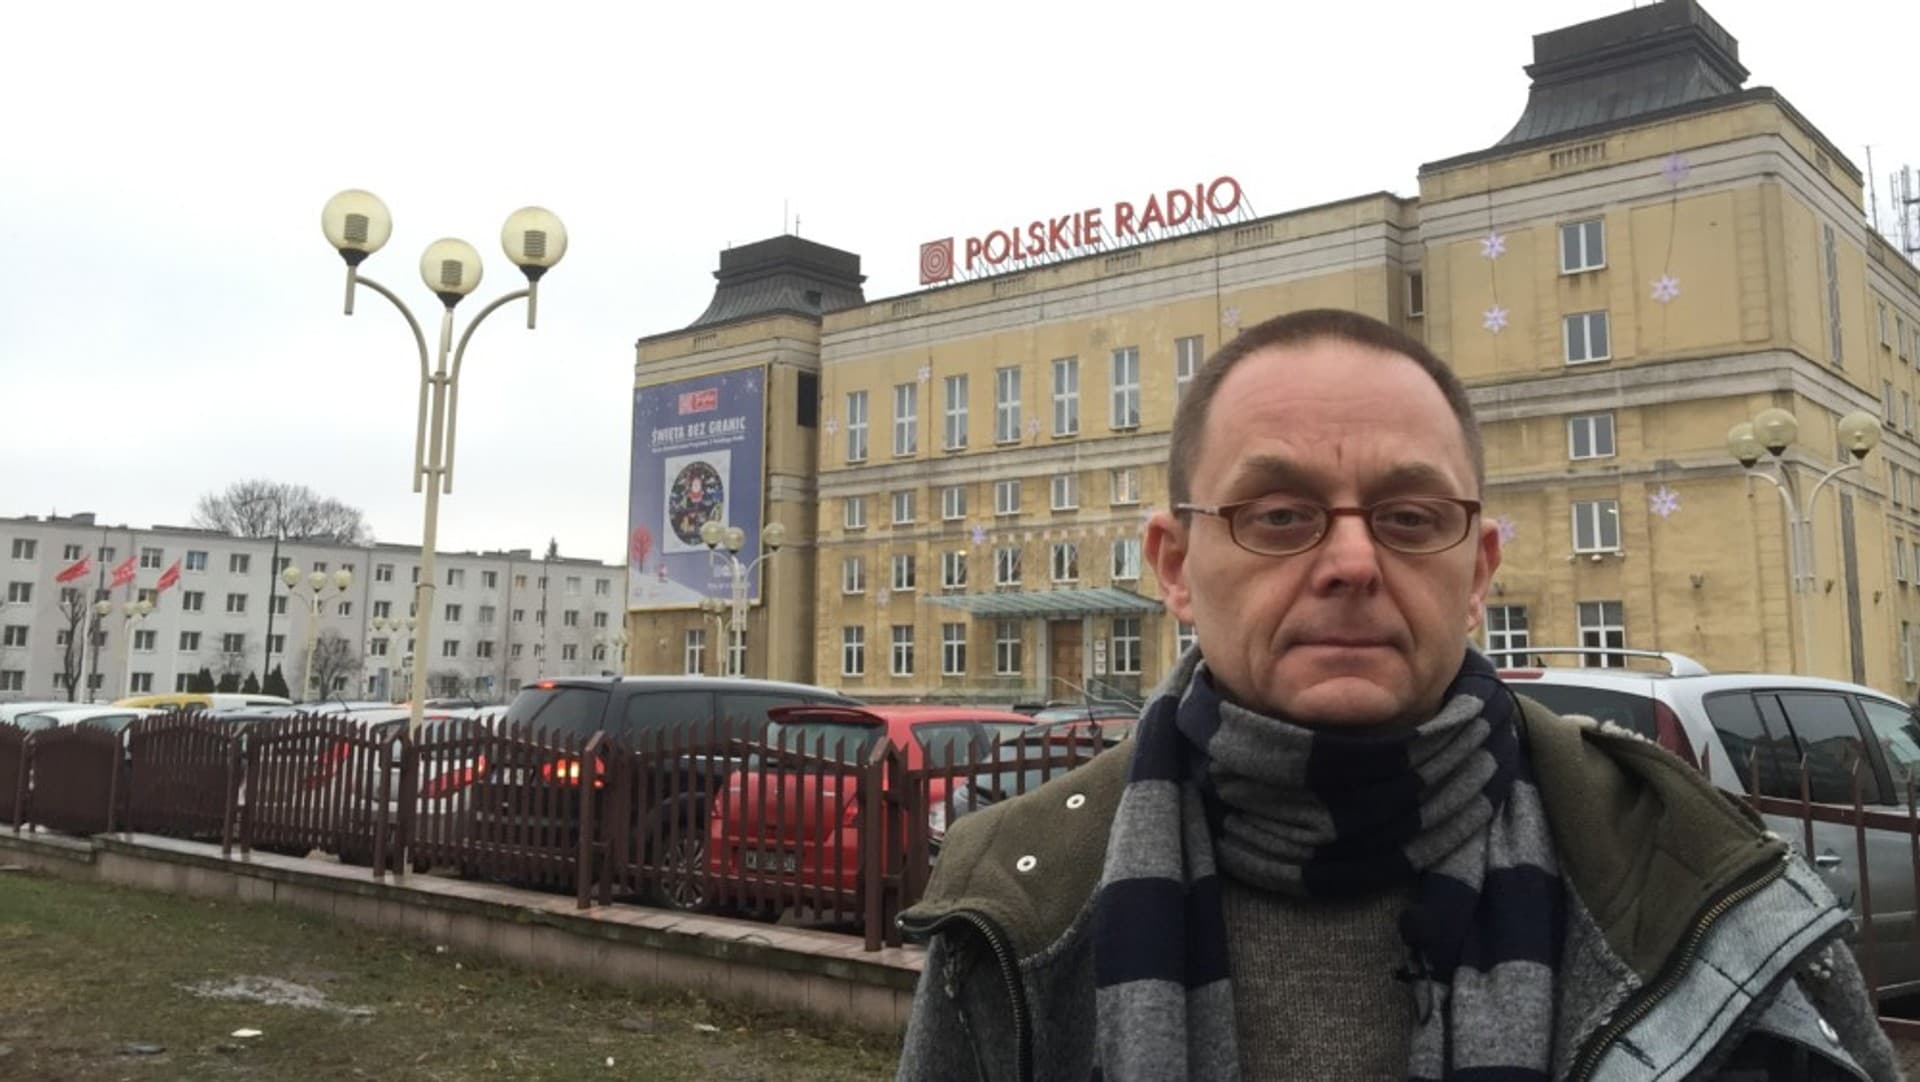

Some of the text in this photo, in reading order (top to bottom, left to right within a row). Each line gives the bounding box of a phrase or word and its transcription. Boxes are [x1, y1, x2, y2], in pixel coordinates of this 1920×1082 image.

[965, 176, 1242, 271] POLSKIE RADIO
[687, 421, 706, 438] BEZ
[708, 415, 747, 435] GRANIC
